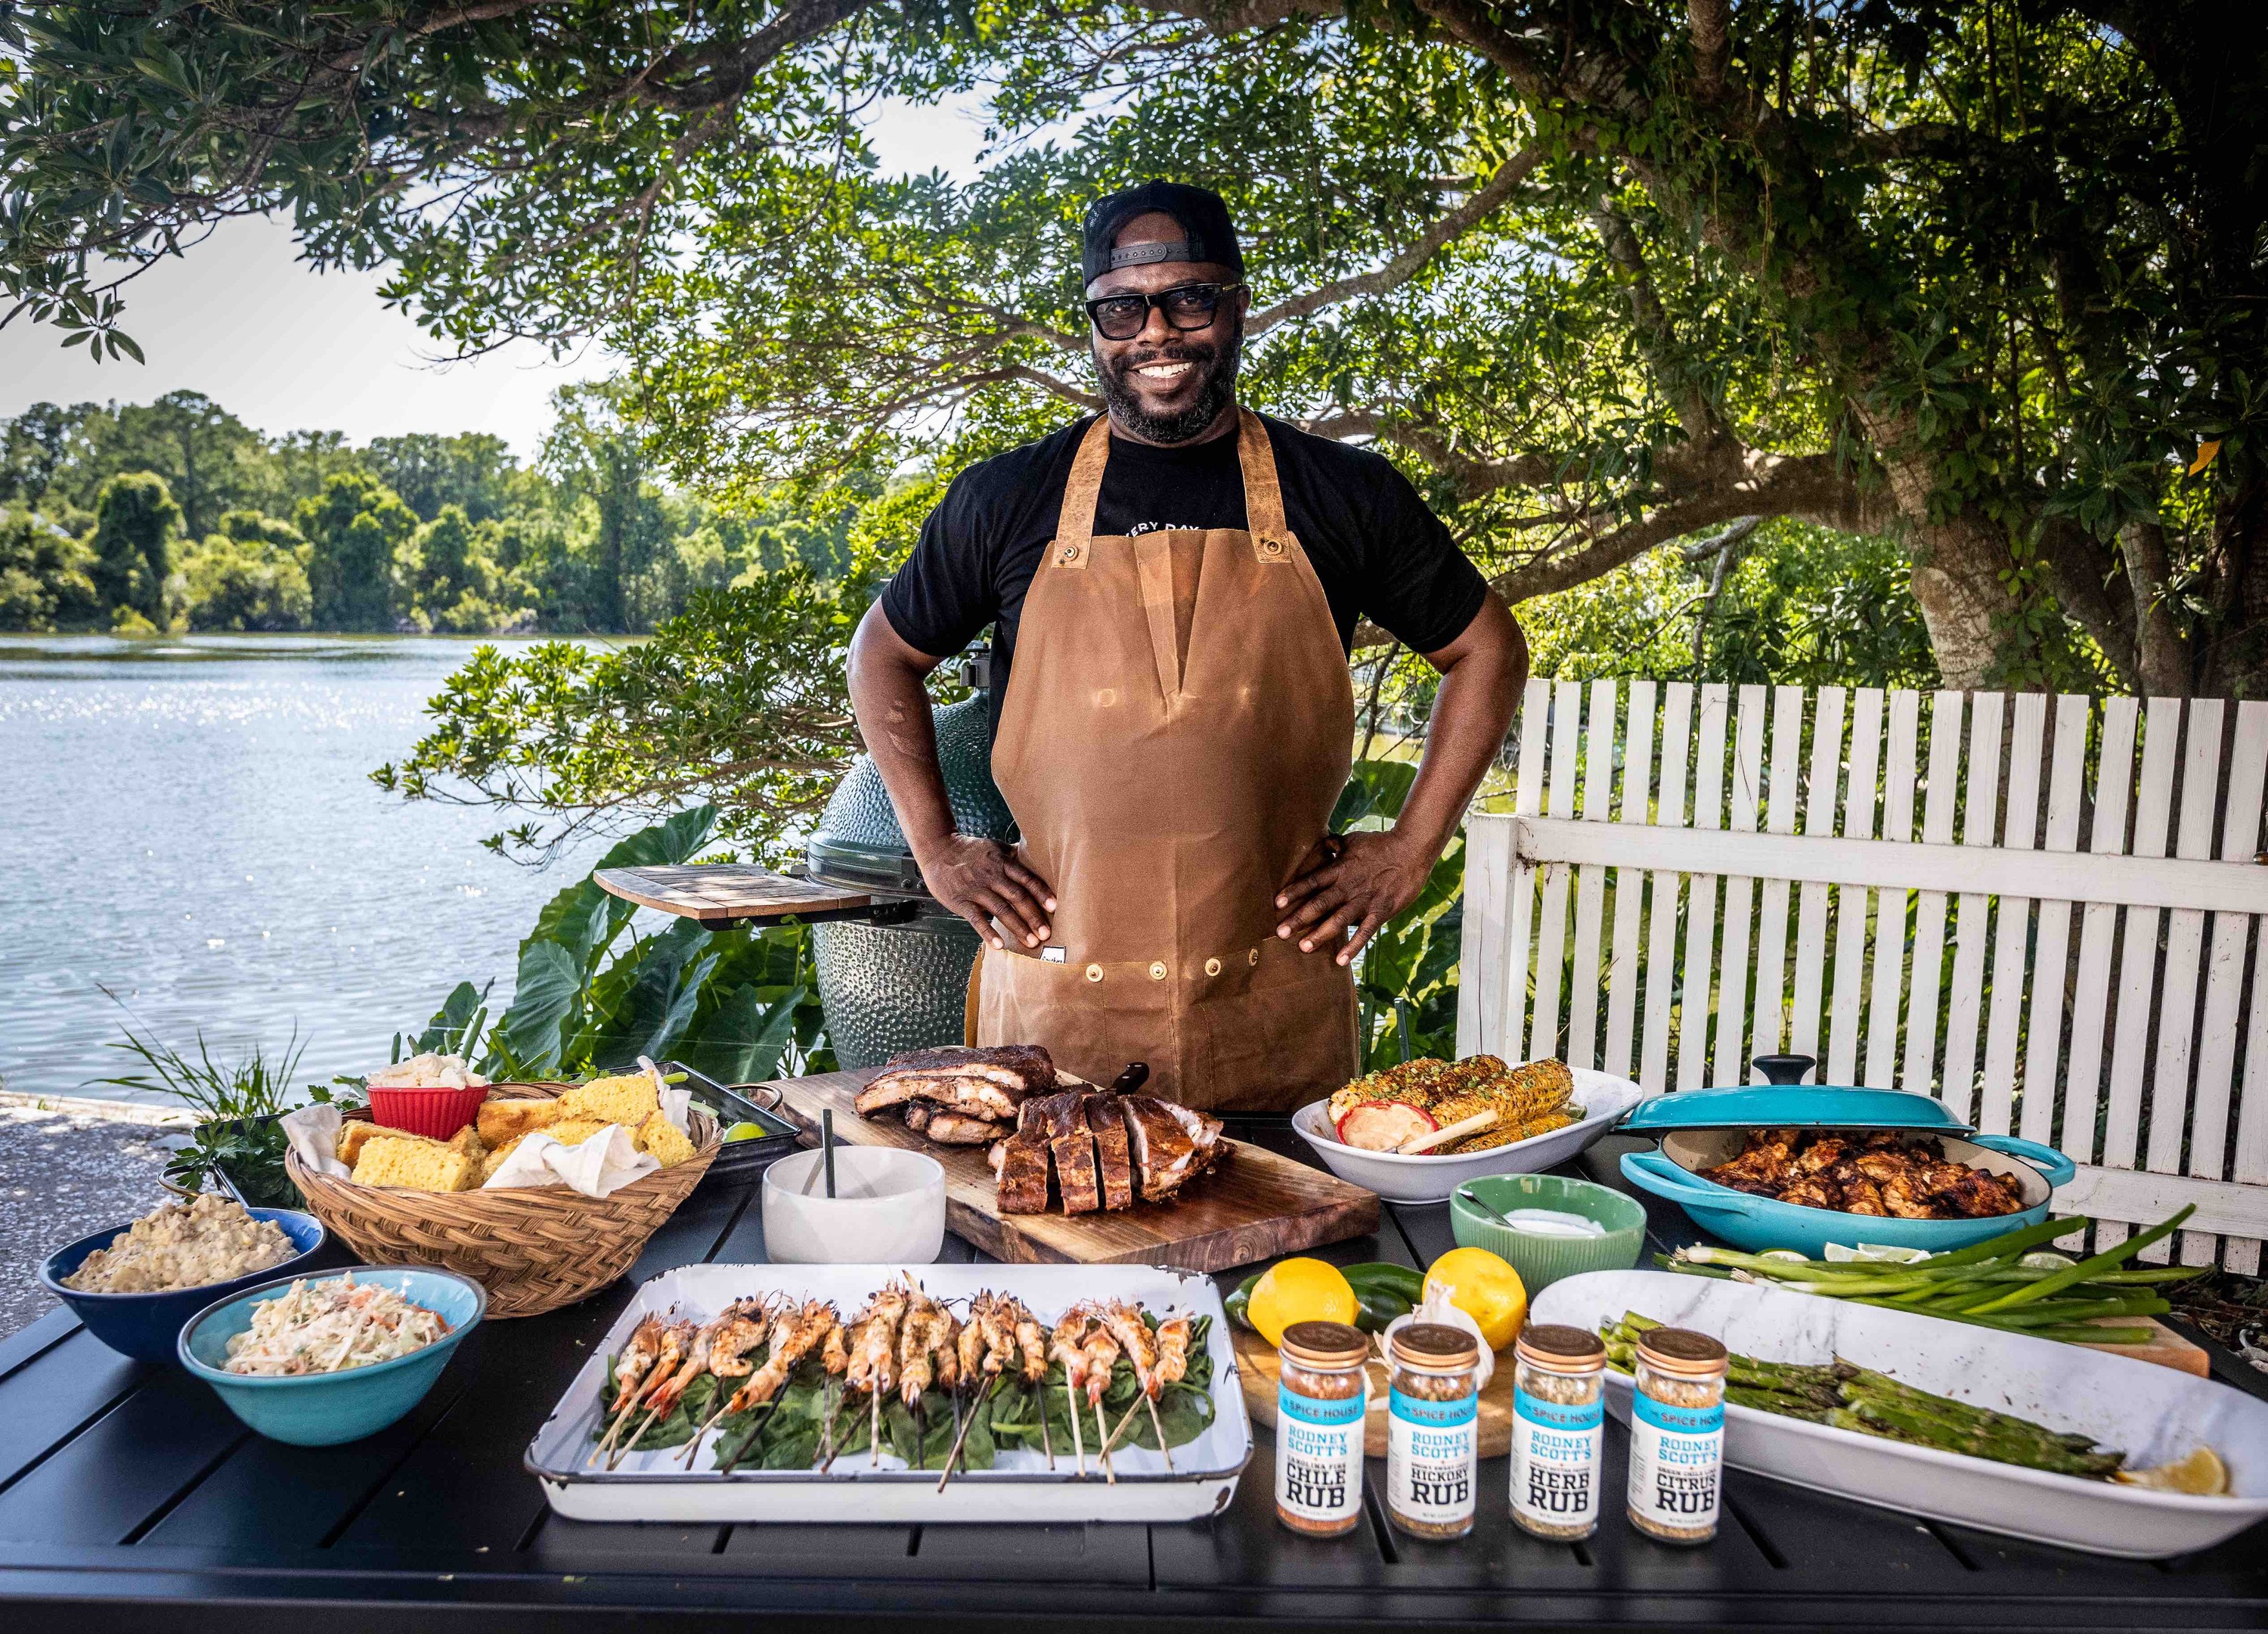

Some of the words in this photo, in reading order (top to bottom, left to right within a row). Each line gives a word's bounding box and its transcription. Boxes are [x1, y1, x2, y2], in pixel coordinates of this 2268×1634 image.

[1290, 1400, 1320, 1418] SPICE
[1323, 1404, 1359, 1418] HOUSE
[1411, 1407, 1445, 1420] SPICE
[1533, 1407, 1567, 1423] SPICE
[1661, 1412, 1696, 1427] SPICE
[1289, 1425, 1348, 1443] RODNEY
[1411, 1431, 1470, 1446] RODNEY
[1532, 1430, 1591, 1449] RODNEY
[1287, 1437, 1348, 1456] SCOTT'S
[1411, 1443, 1470, 1459] SCOTT'S
[1530, 1443, 1591, 1461] SCOTT'S
[1659, 1436, 1718, 1452] RODNEY
[1658, 1449, 1718, 1465] SCOTT'S
[1287, 1462, 1346, 1486] CHILE
[1411, 1467, 1467, 1482] HICKORY
[1529, 1465, 1589, 1490] HERB
[1656, 1473, 1716, 1490] CITRUS
[1286, 1478, 1345, 1508] RUB
[1411, 1480, 1468, 1505] RUB
[1527, 1484, 1588, 1512] RUB
[1656, 1487, 1715, 1513] RUB
